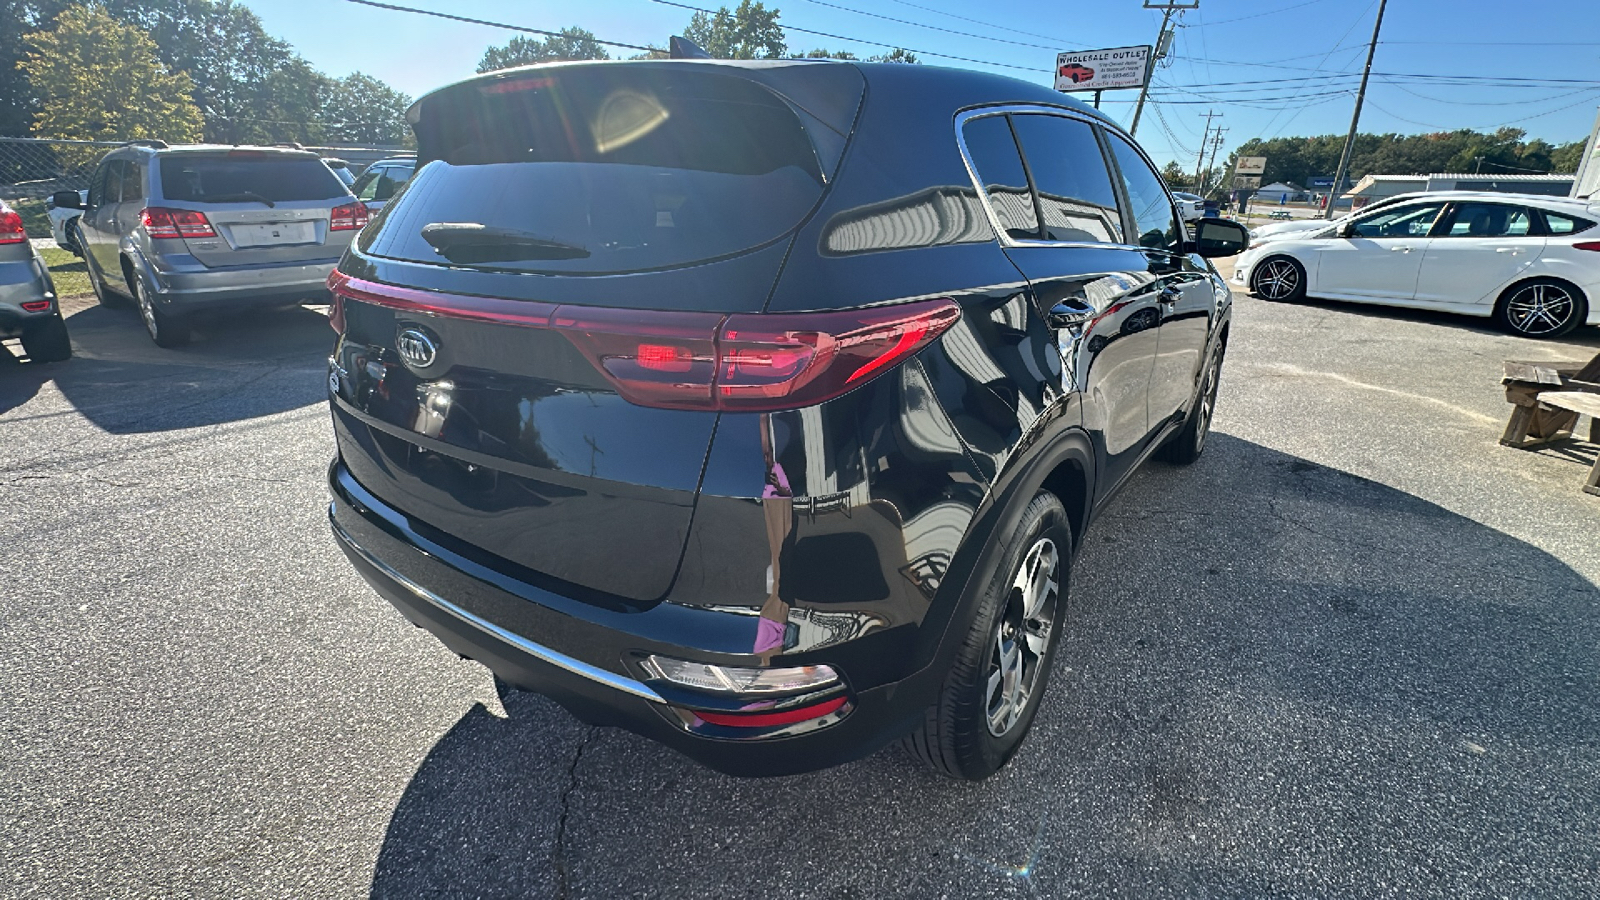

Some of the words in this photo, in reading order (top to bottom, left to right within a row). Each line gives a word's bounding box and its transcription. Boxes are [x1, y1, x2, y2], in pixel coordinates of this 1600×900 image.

[1059, 53, 1109, 64] WHOLESALE
[1113, 50, 1147, 59] OUTLET
[400, 336, 428, 362] KIA
